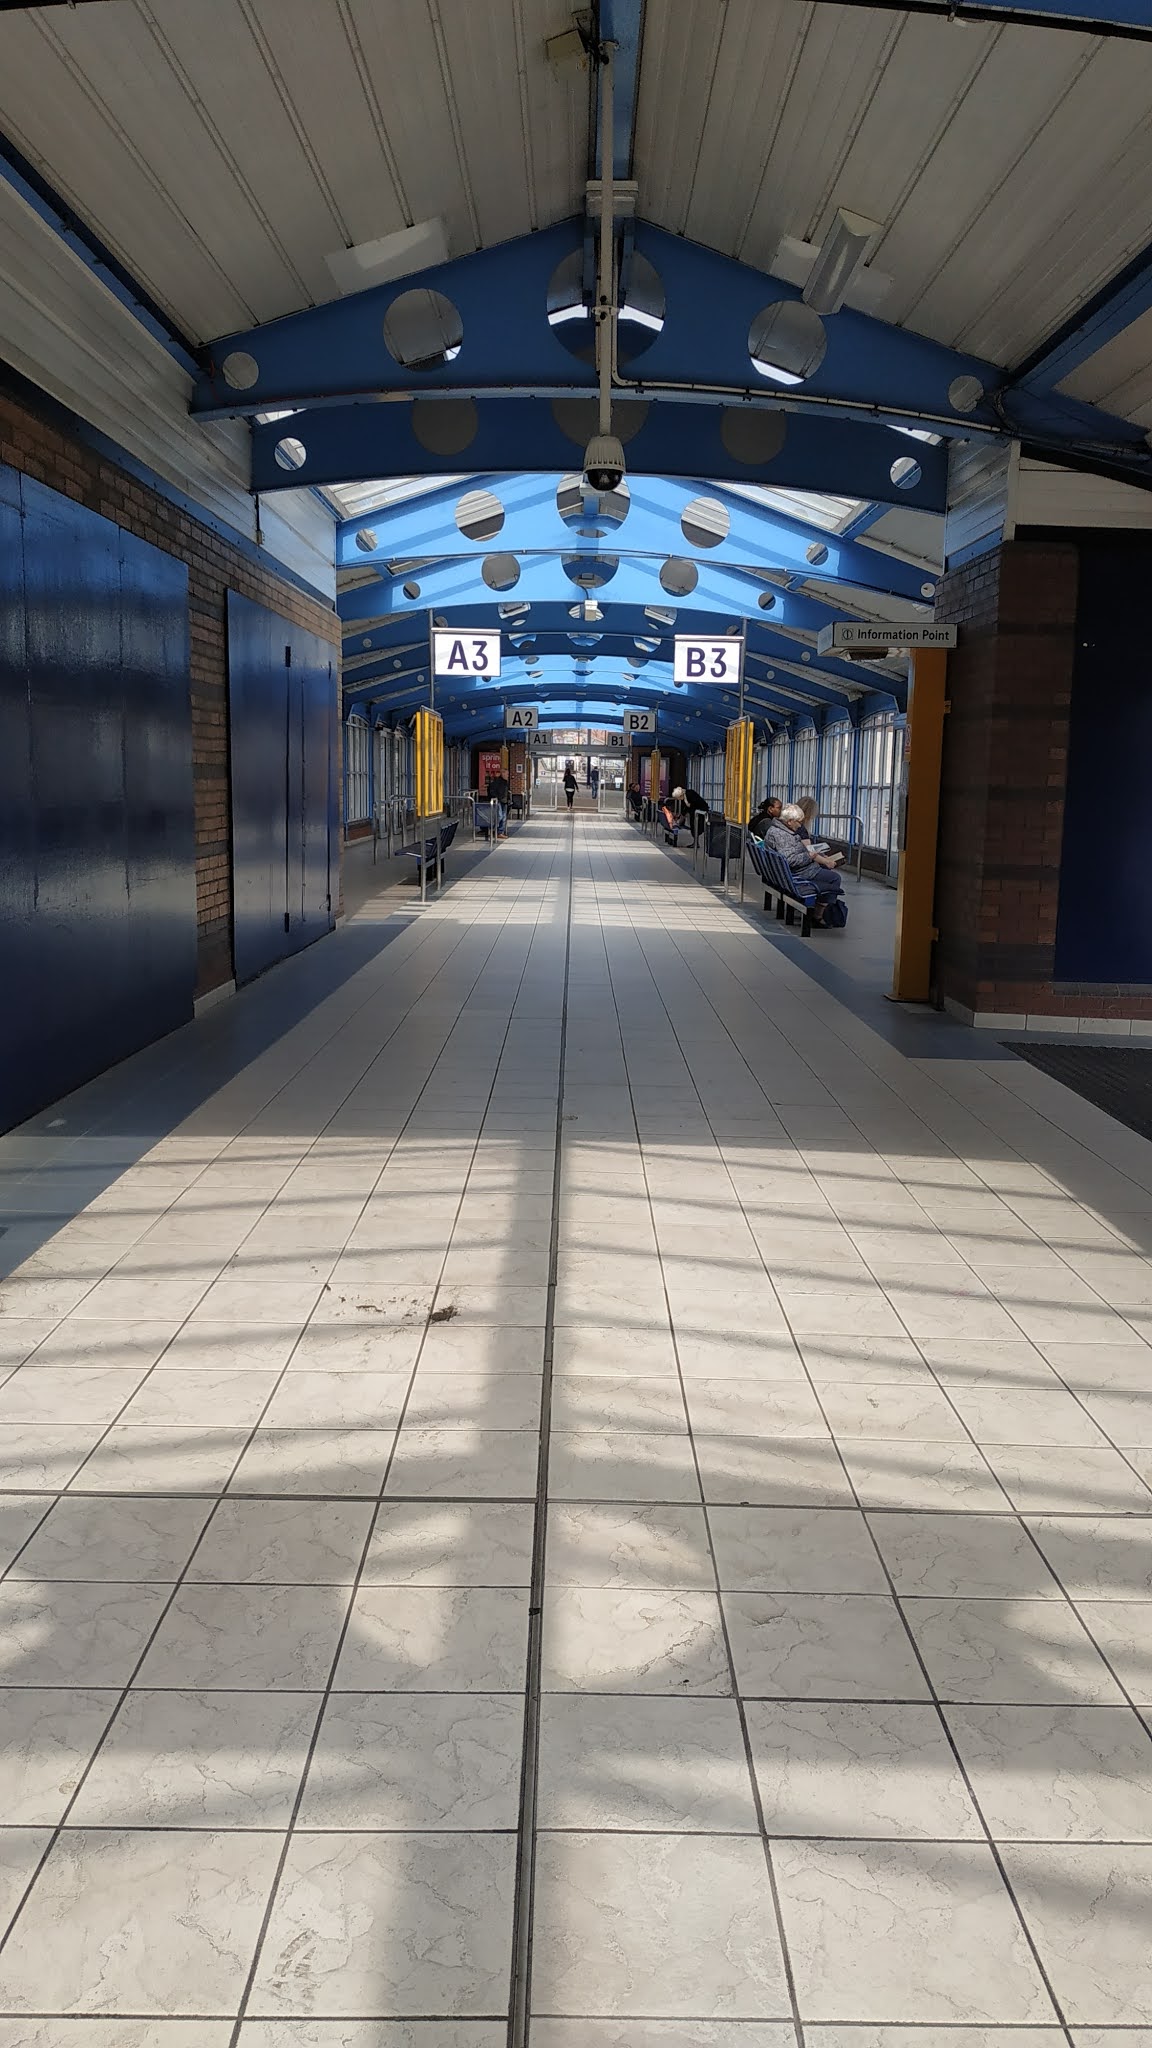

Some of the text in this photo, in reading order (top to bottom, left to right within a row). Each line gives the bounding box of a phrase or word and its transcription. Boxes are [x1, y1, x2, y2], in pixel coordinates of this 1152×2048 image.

[858, 629, 949, 641] Information Point
[447, 640, 489, 672] A3
[686, 647, 728, 678] B3
[512, 711, 533, 727] A2
[630, 715, 649, 730] B2
[533, 734, 548, 744] A1
[611, 736, 625, 746] B1
[482, 754, 501, 762] sprin
